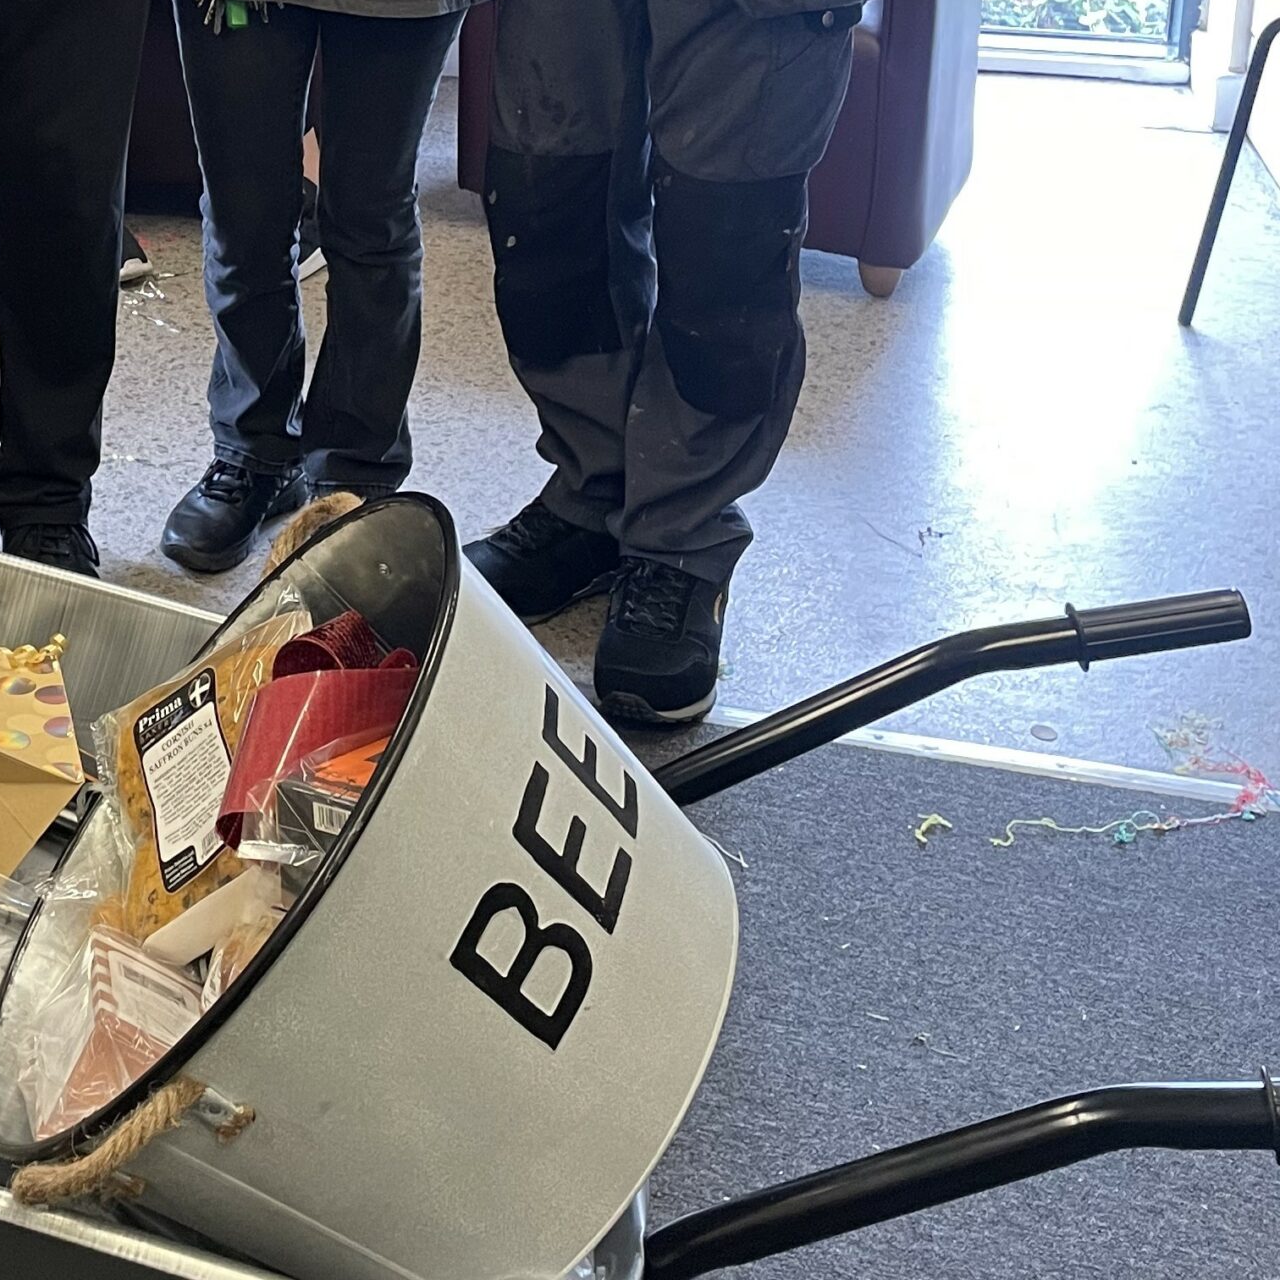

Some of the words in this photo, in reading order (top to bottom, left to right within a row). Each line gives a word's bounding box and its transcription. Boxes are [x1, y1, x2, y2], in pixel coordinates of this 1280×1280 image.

[137, 695, 183, 734] Prima
[148, 743, 184, 774] SAFFRON
[184, 727, 205, 748] BUNS
[160, 719, 195, 752] CORNISH
